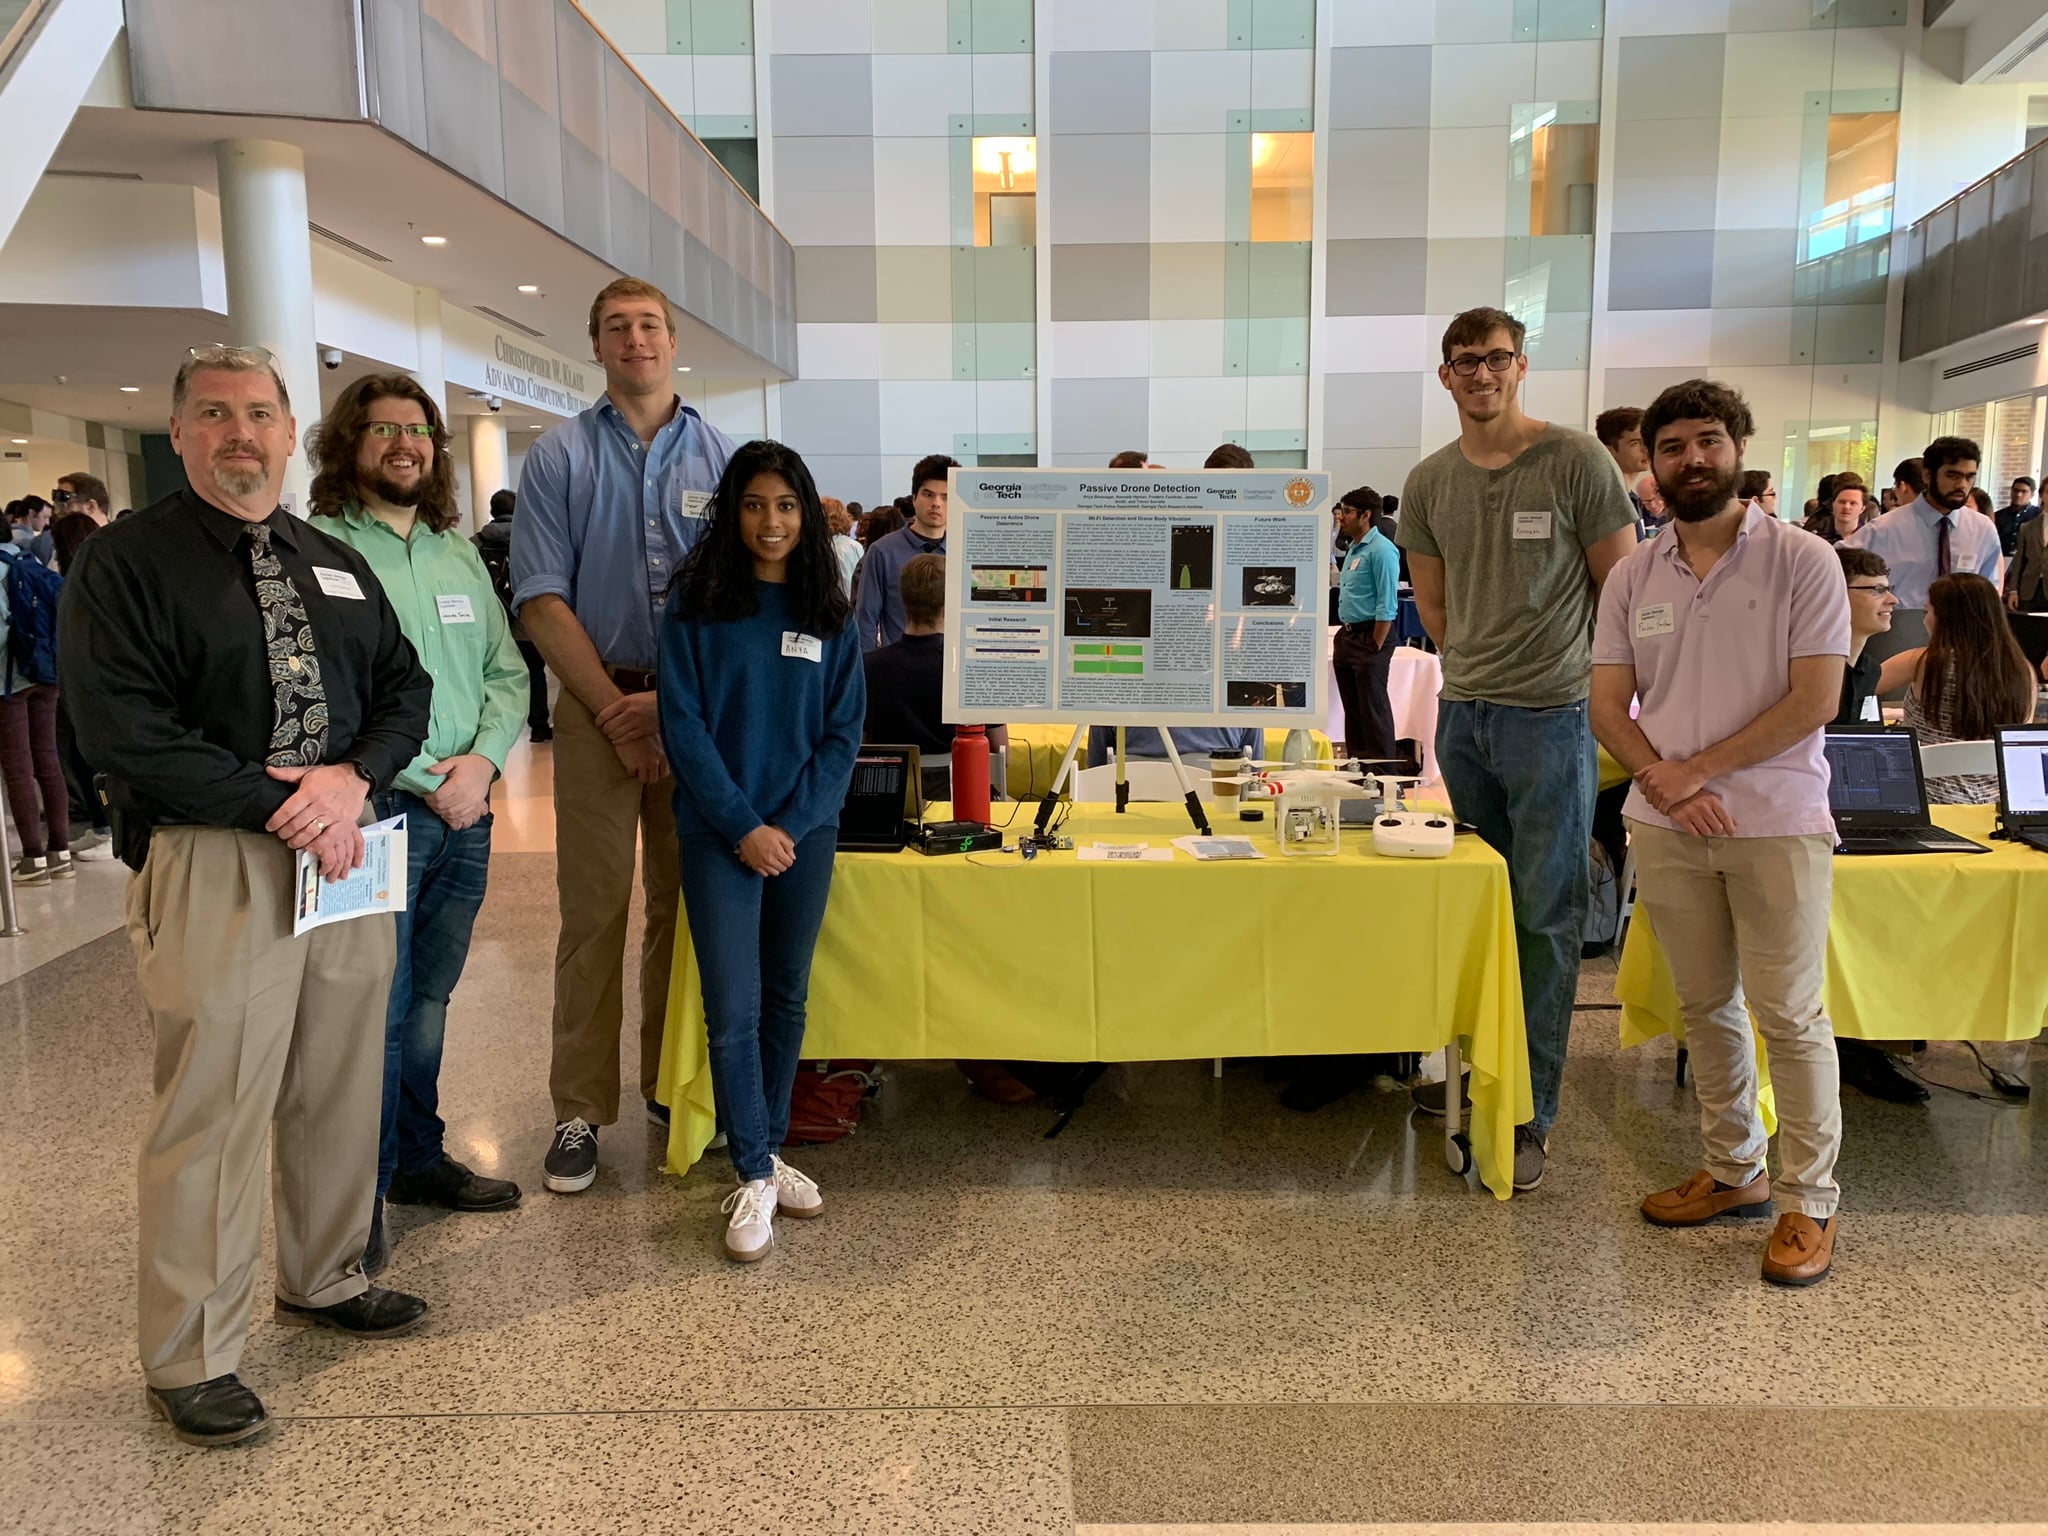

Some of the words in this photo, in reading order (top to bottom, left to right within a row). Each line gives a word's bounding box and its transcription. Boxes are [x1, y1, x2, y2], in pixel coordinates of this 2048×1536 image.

[485, 361, 527, 397] ADVANCED
[527, 377, 566, 409] COMPUTING
[562, 363, 585, 393] KLAUS
[979, 483, 1022, 492] Georgia
[1079, 483, 1118, 493] Passive
[1120, 483, 1151, 493] Drone
[1153, 483, 1201, 493] Detection
